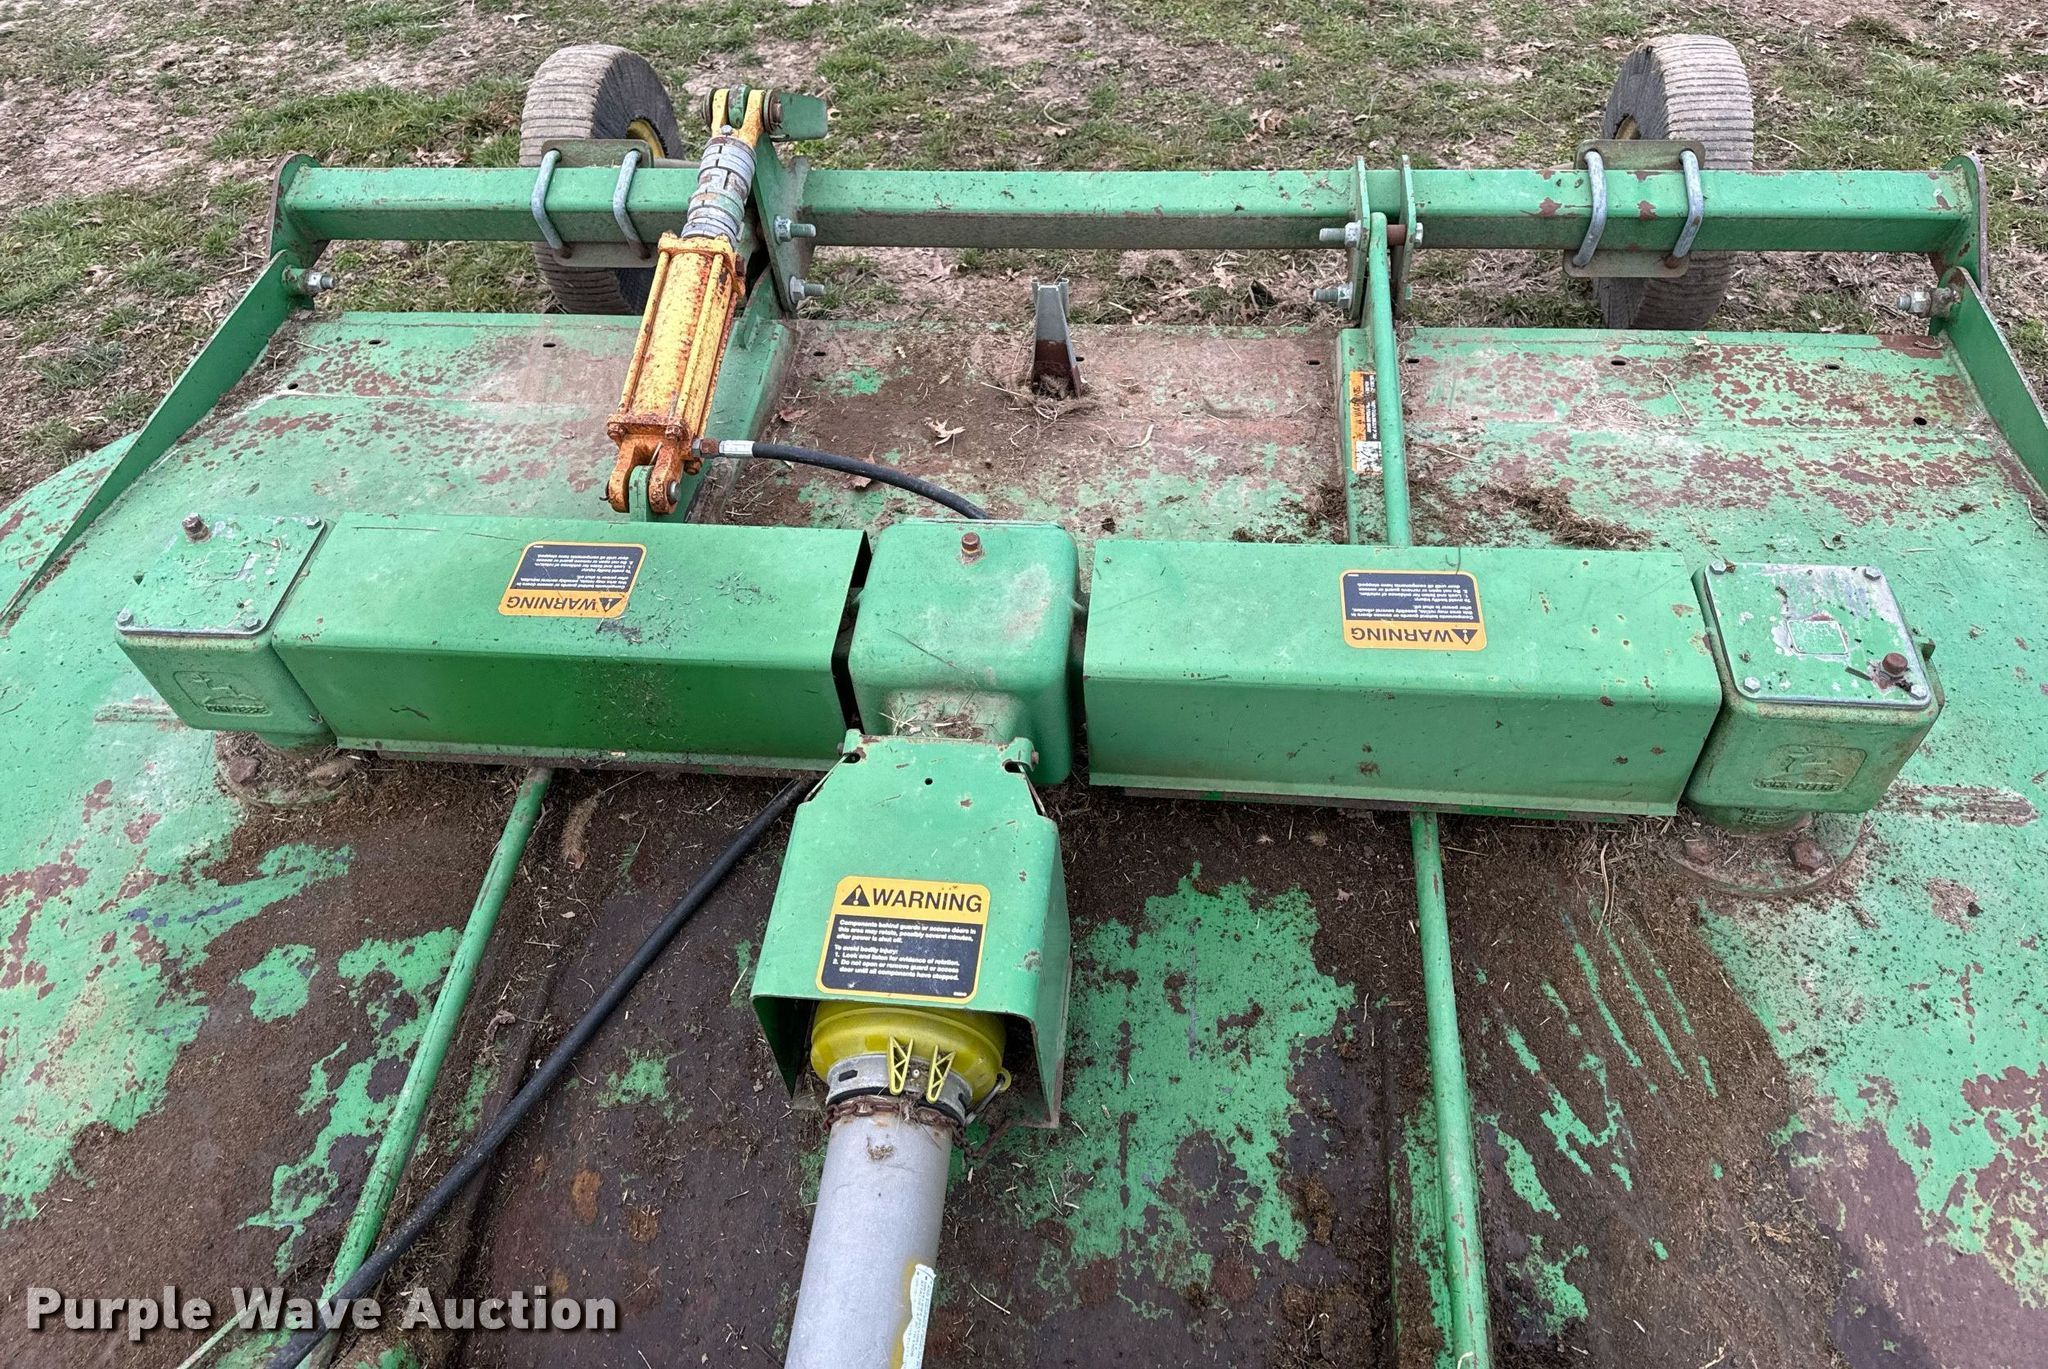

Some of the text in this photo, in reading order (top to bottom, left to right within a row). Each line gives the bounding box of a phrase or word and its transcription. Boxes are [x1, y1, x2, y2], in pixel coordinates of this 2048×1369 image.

[506, 596, 597, 611] WARNING
[1350, 627, 1454, 644] WARNING
[872, 887, 982, 913] WARNING
